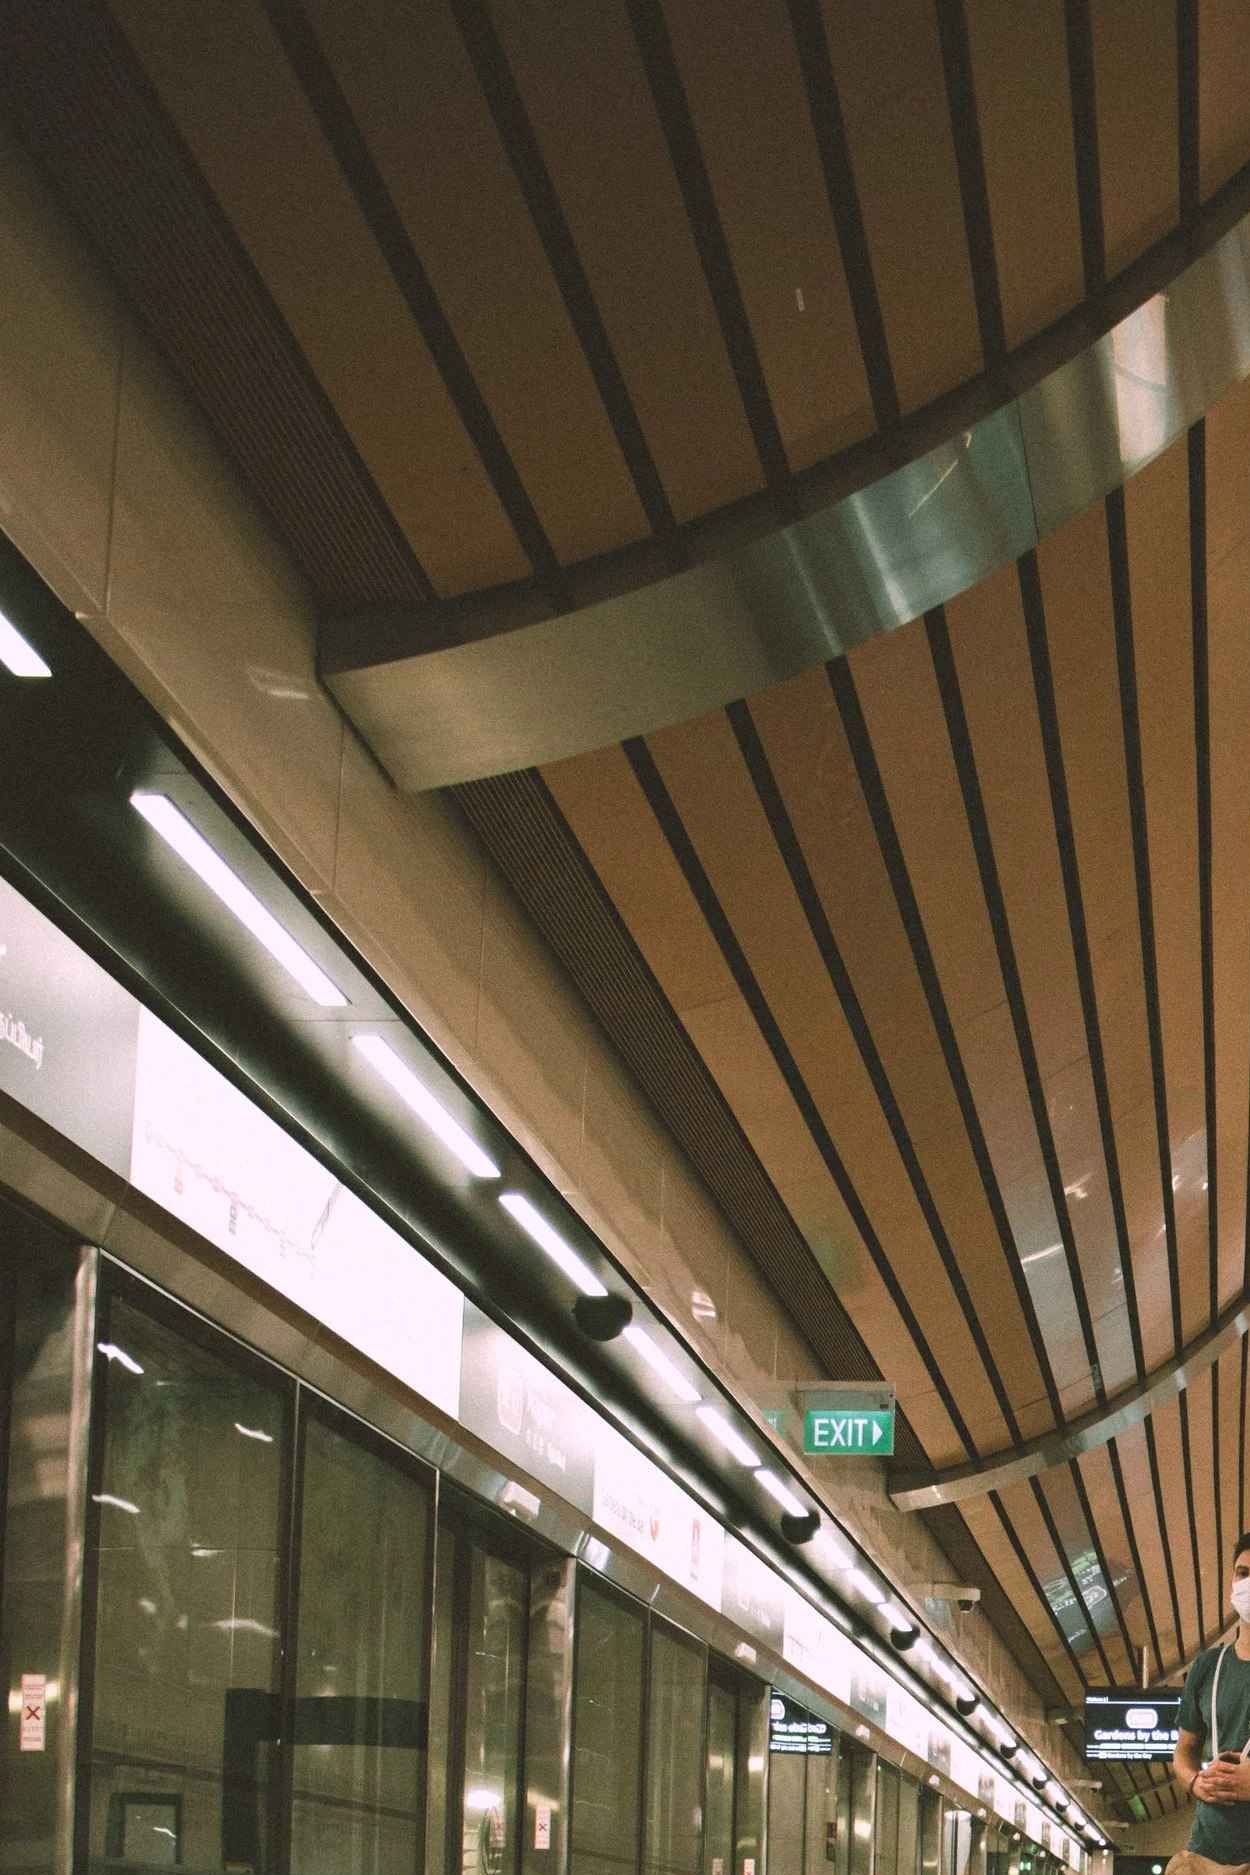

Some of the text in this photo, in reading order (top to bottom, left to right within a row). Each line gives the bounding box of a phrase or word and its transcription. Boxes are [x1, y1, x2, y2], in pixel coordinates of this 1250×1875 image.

[814, 1418, 868, 1447] EXIT
[1094, 1729, 1136, 1741] Gardens
[1137, 1729, 1150, 1742] by
[1151, 1729, 1170, 1741] the
